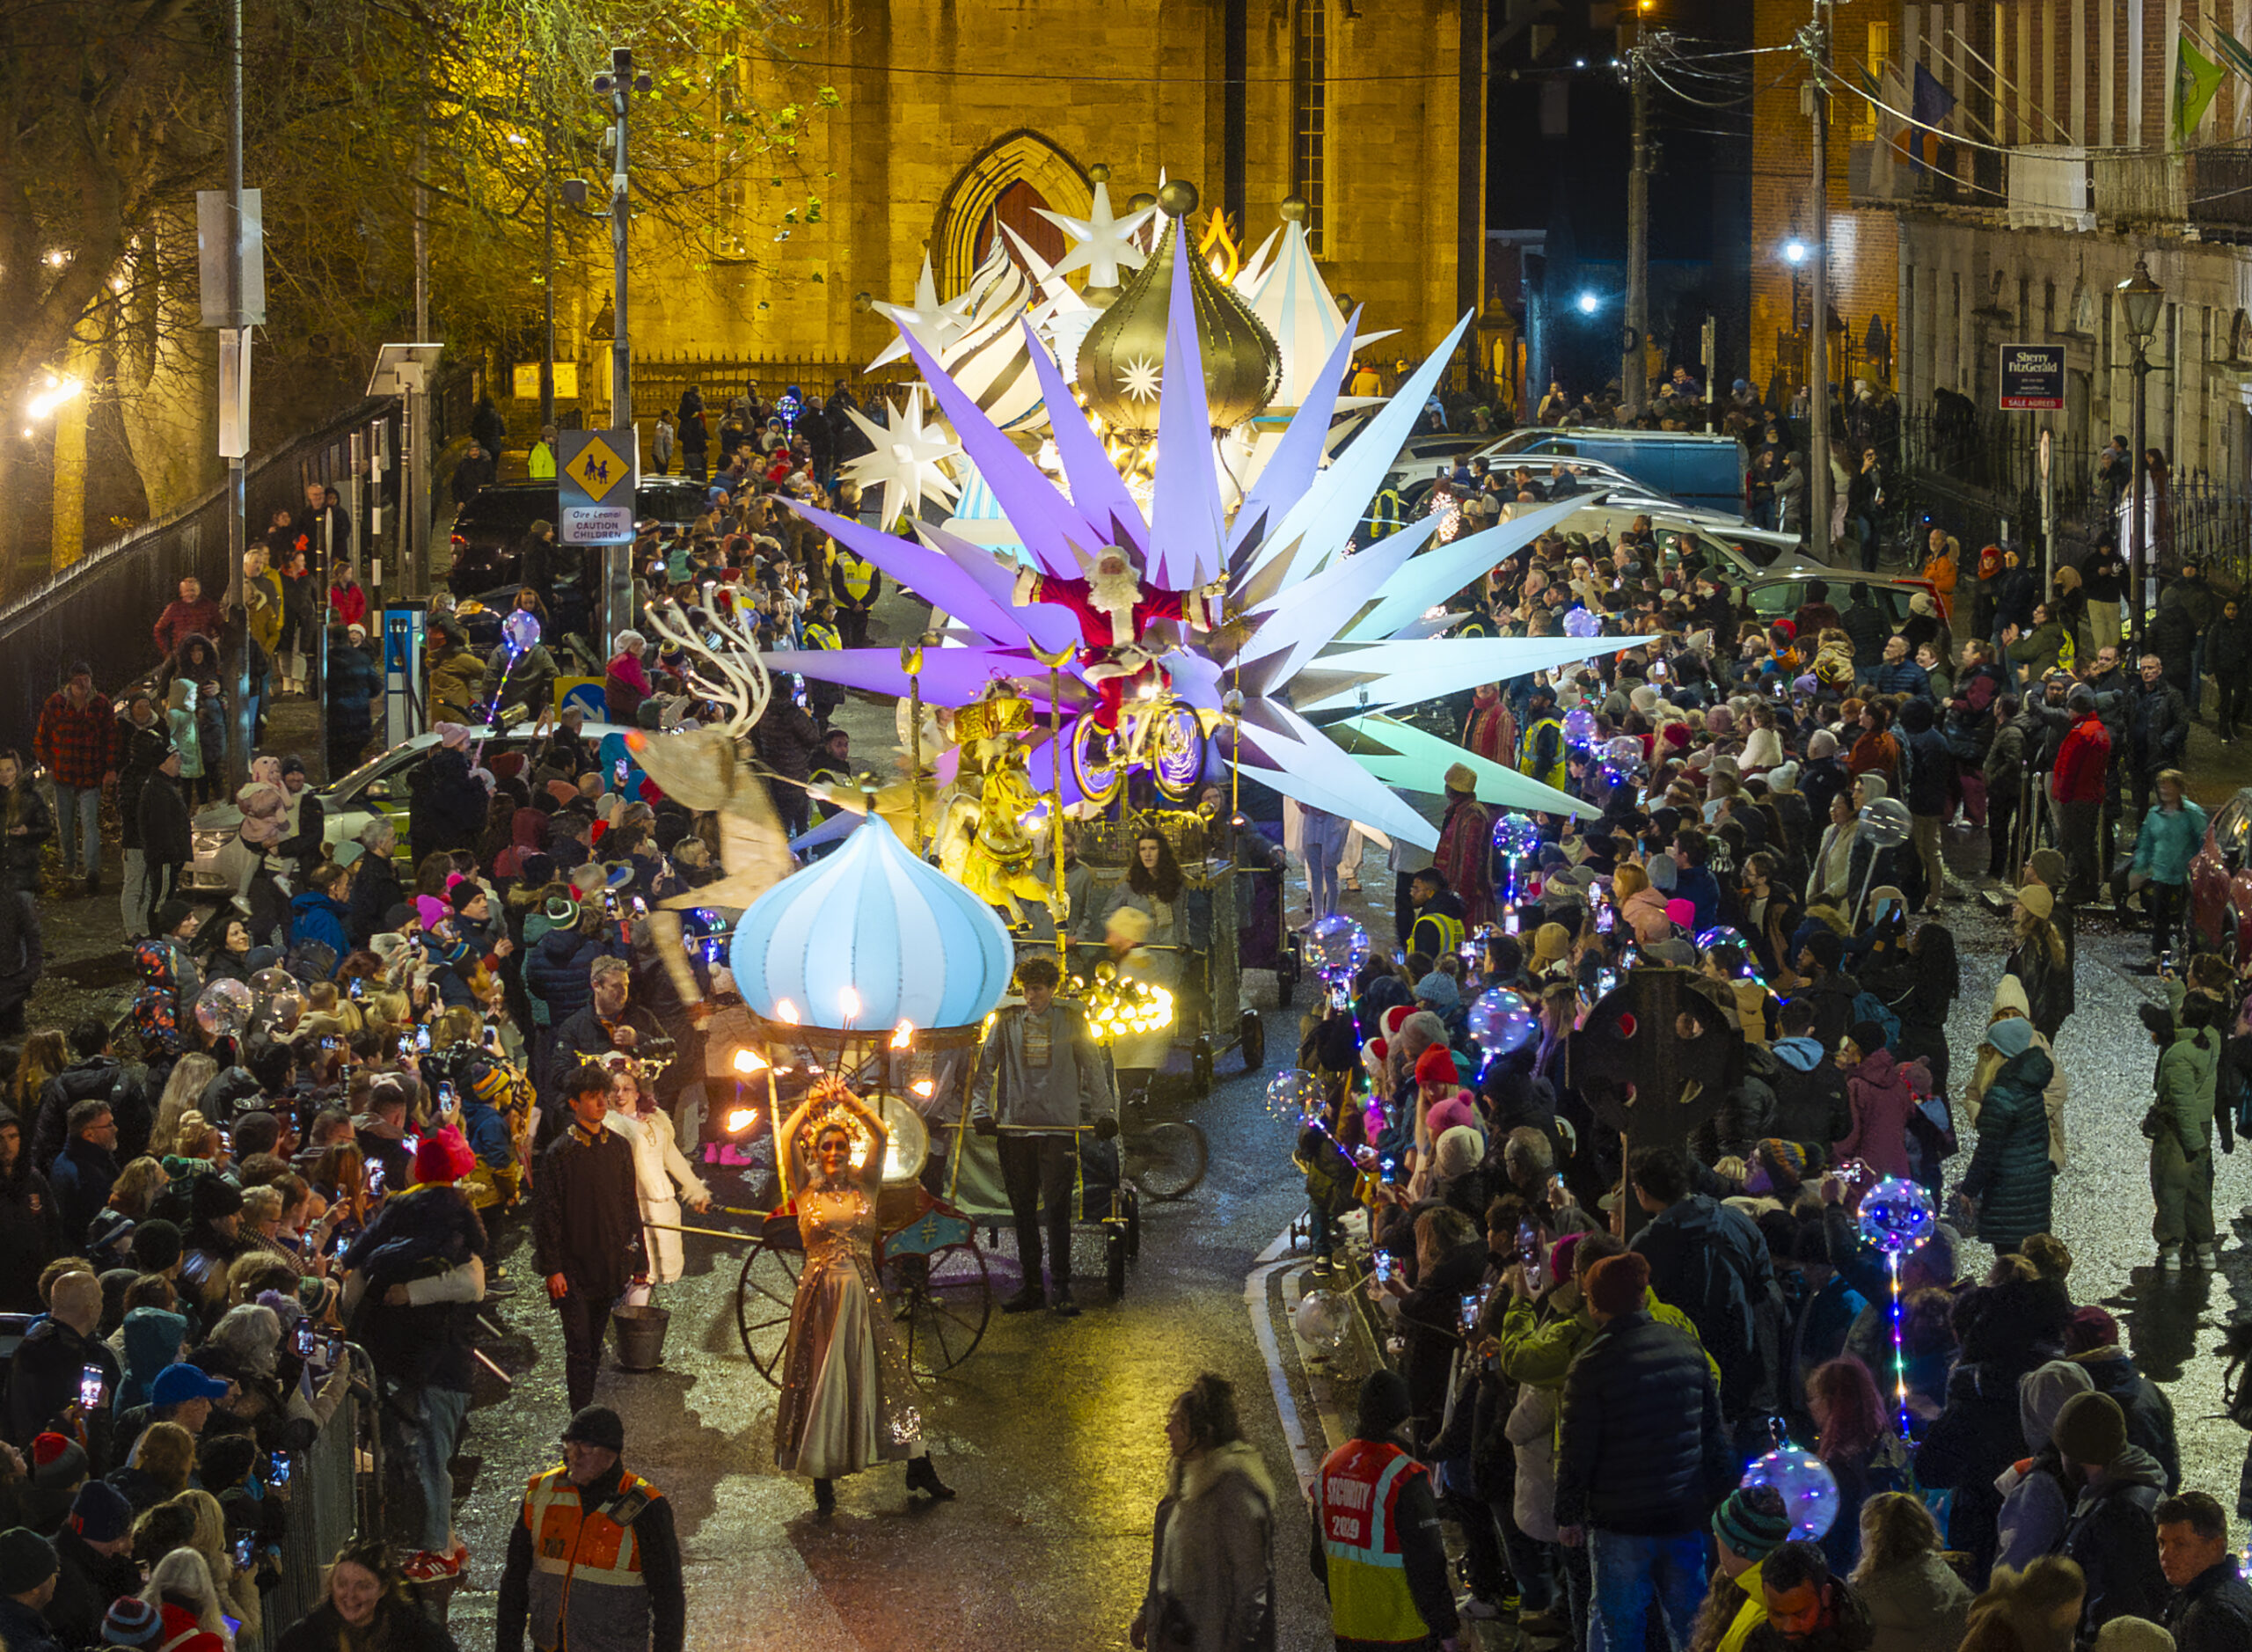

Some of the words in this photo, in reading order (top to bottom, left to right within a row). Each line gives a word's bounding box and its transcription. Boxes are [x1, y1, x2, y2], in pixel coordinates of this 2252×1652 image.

[2016, 351, 2049, 363] Sherry
[2008, 362, 2058, 373] FitzGerald
[573, 530, 621, 539] CHILDREN
[1327, 1476, 1372, 1511] SECURITY
